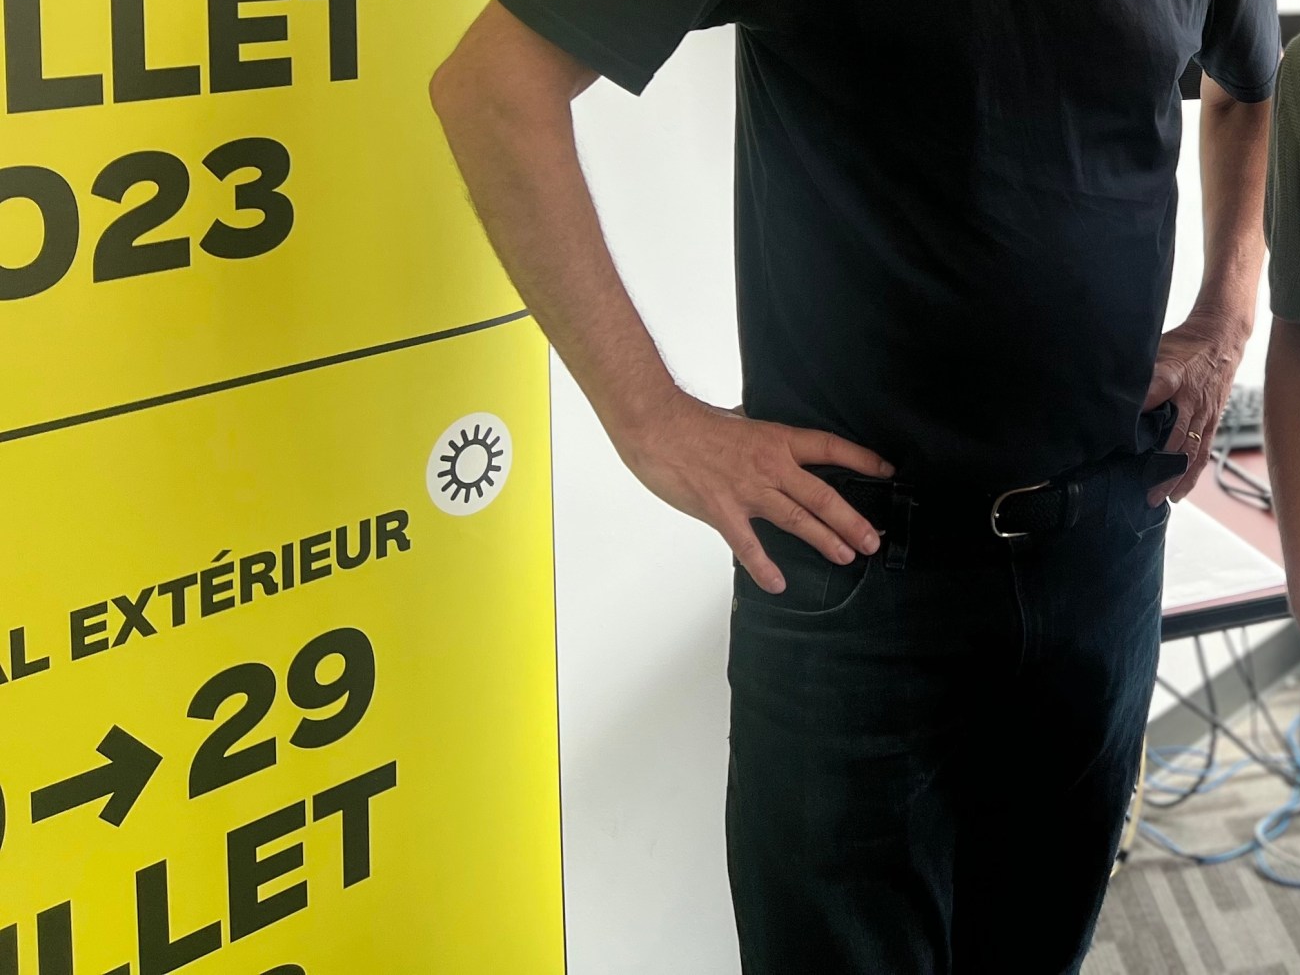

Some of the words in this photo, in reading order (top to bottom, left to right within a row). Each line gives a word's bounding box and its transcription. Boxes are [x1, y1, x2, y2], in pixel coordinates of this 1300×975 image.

[0, 137, 295, 301] 023
[70, 510, 411, 662] EXTÉRIEUR
[186, 627, 376, 799] 29
